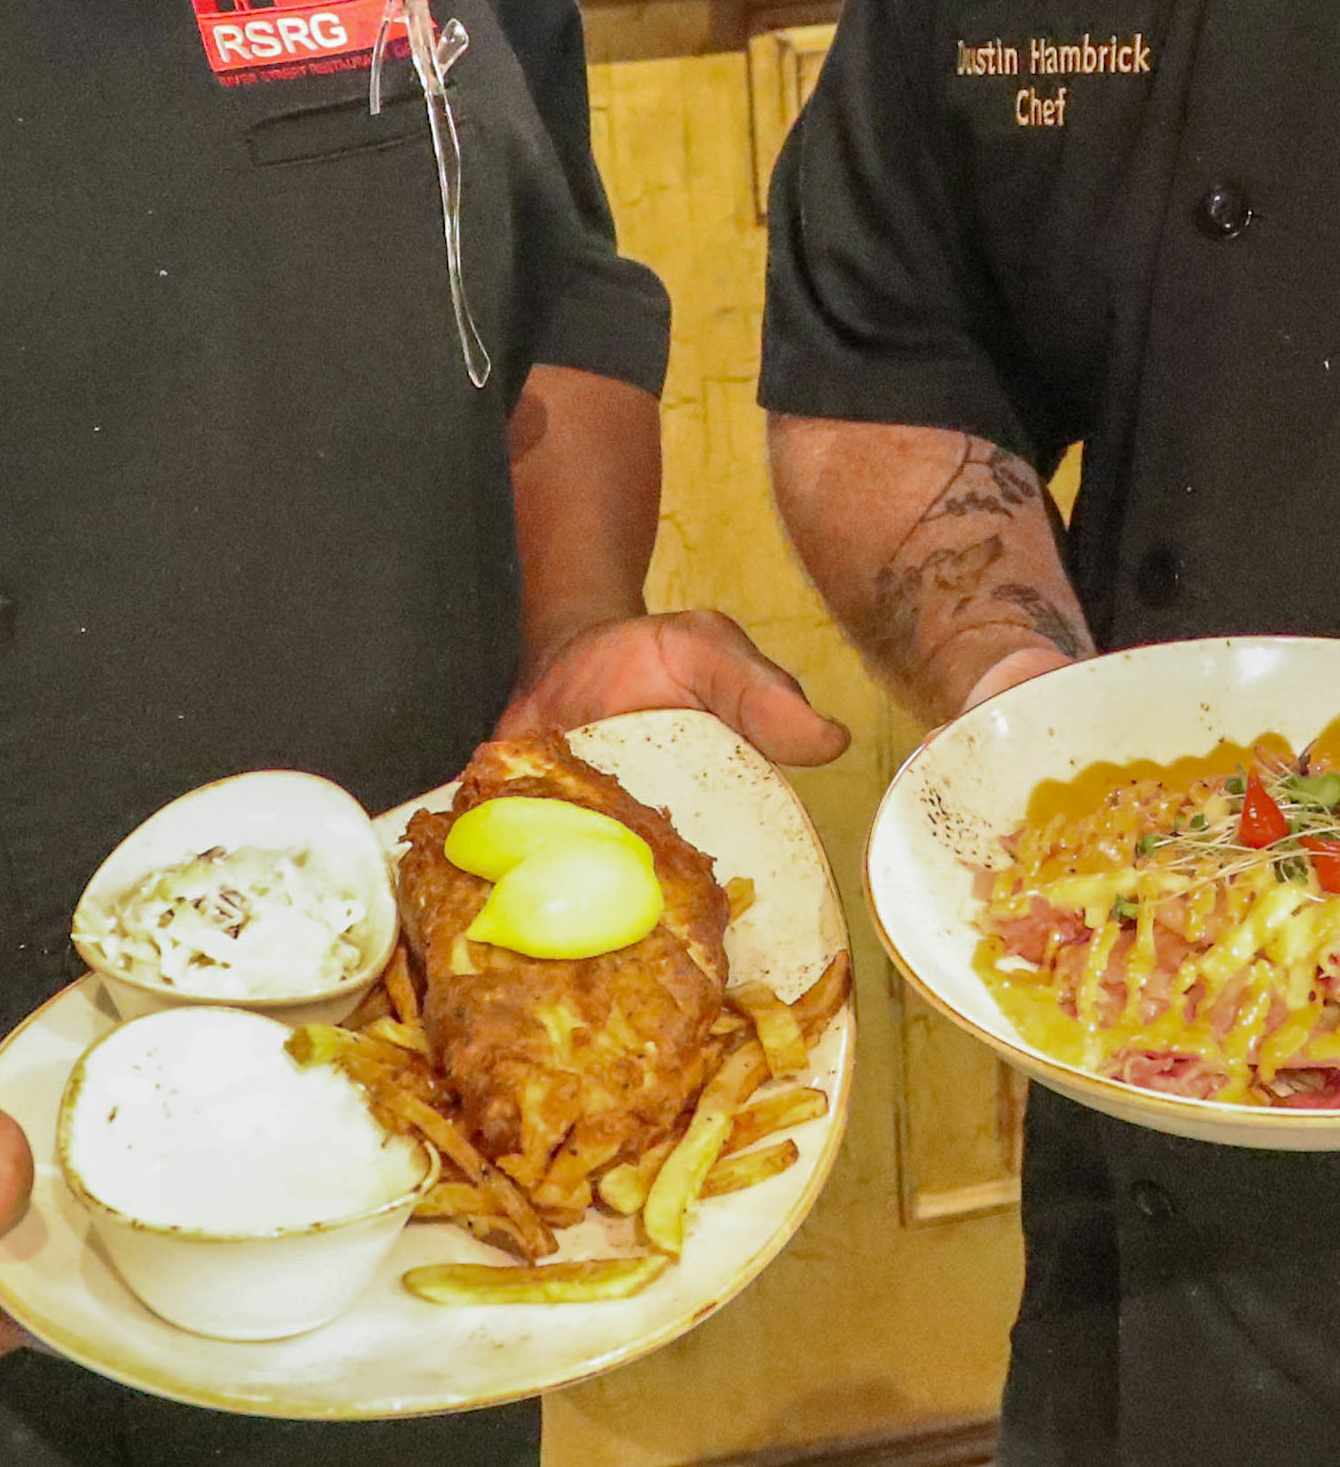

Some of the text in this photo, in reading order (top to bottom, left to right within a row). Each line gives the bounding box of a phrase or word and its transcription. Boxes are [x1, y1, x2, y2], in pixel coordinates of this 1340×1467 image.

[212, 12, 349, 64] RSRG
[1030, 32, 1151, 76] Hambrick
[1015, 85, 1067, 127] Chef
